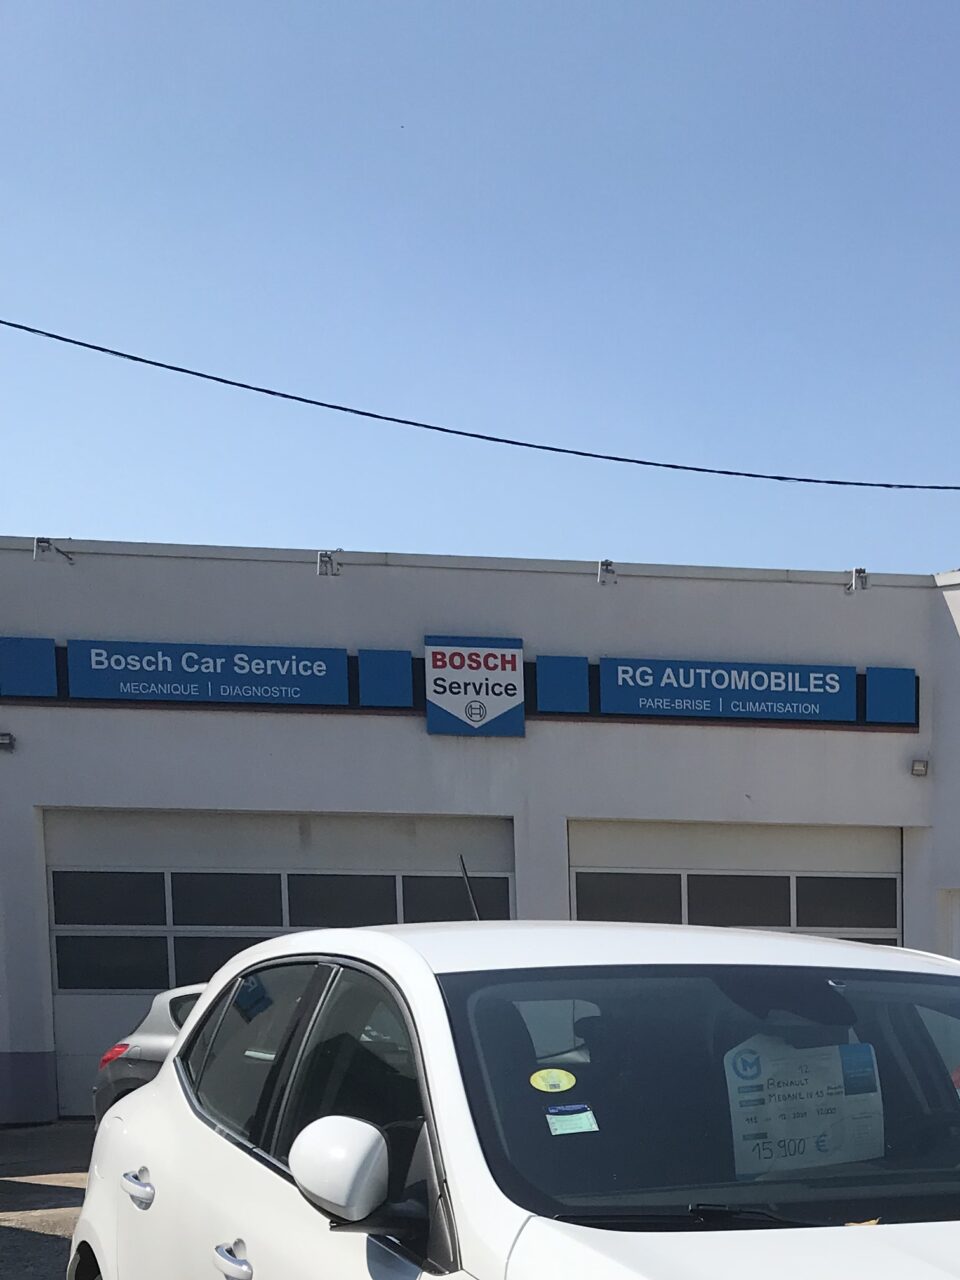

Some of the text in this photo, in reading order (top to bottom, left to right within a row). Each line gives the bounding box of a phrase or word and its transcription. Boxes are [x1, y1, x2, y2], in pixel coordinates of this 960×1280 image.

[90, 648, 327, 677] Bosch Car Service
[431, 651, 517, 672] BOSCH
[119, 682, 301, 698] MECANIQUE DIAGNOSTIC
[432, 677, 518, 697] Service
[617, 666, 841, 694] RG AUTOMOBILES
[639, 697, 820, 715] PARE-BRISE CLIMATISATION
[767, 1078, 809, 1090] RENAULT
